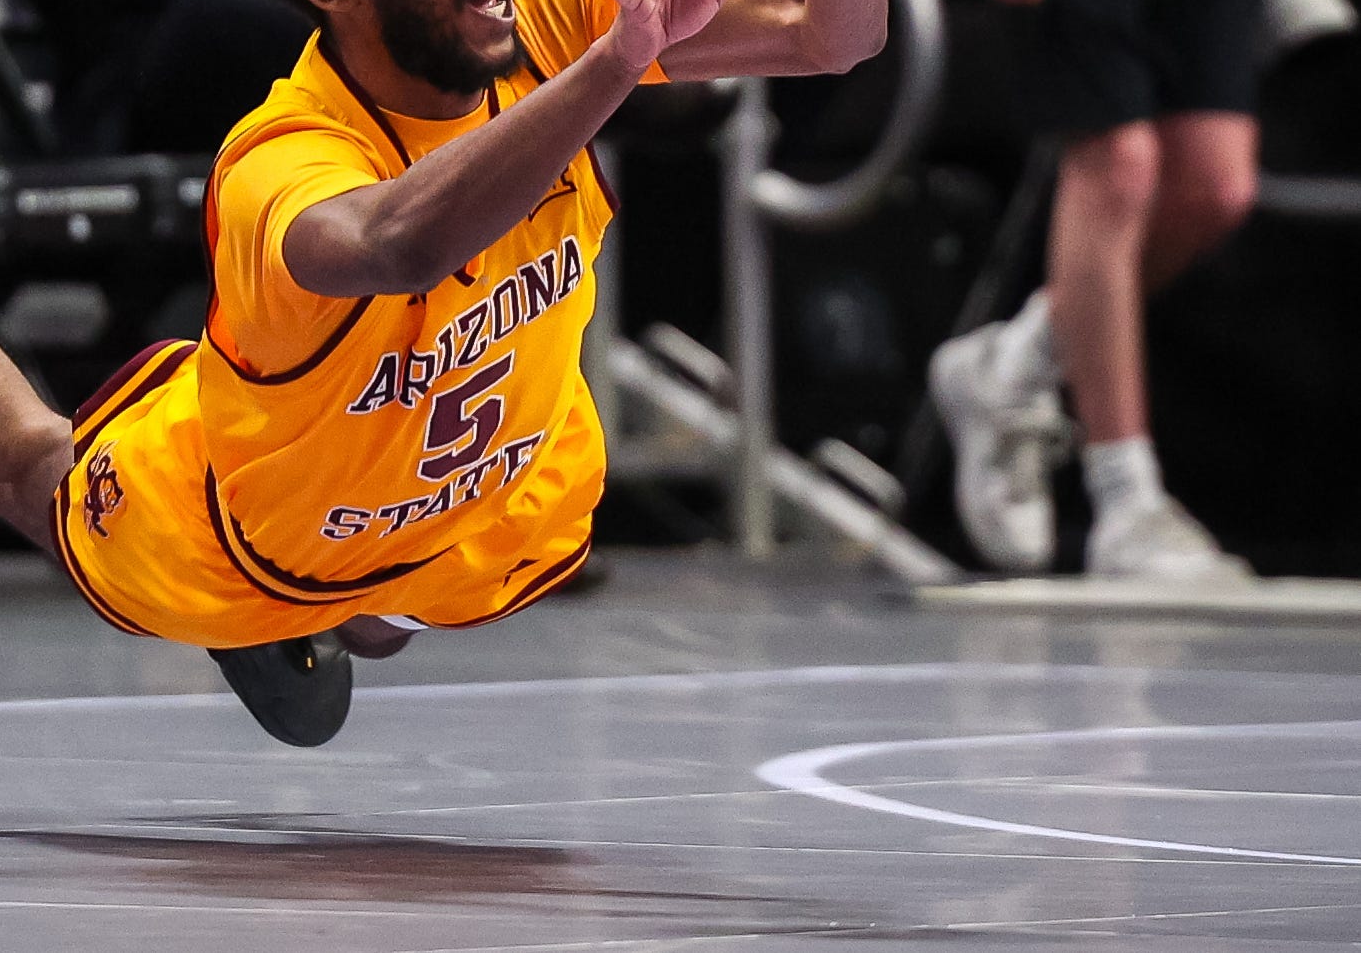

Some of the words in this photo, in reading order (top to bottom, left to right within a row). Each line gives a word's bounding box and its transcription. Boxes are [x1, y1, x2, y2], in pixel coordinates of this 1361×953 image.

[346, 234, 584, 415] ARIZONA
[416, 348, 516, 483] 5
[320, 428, 546, 541] STATE
